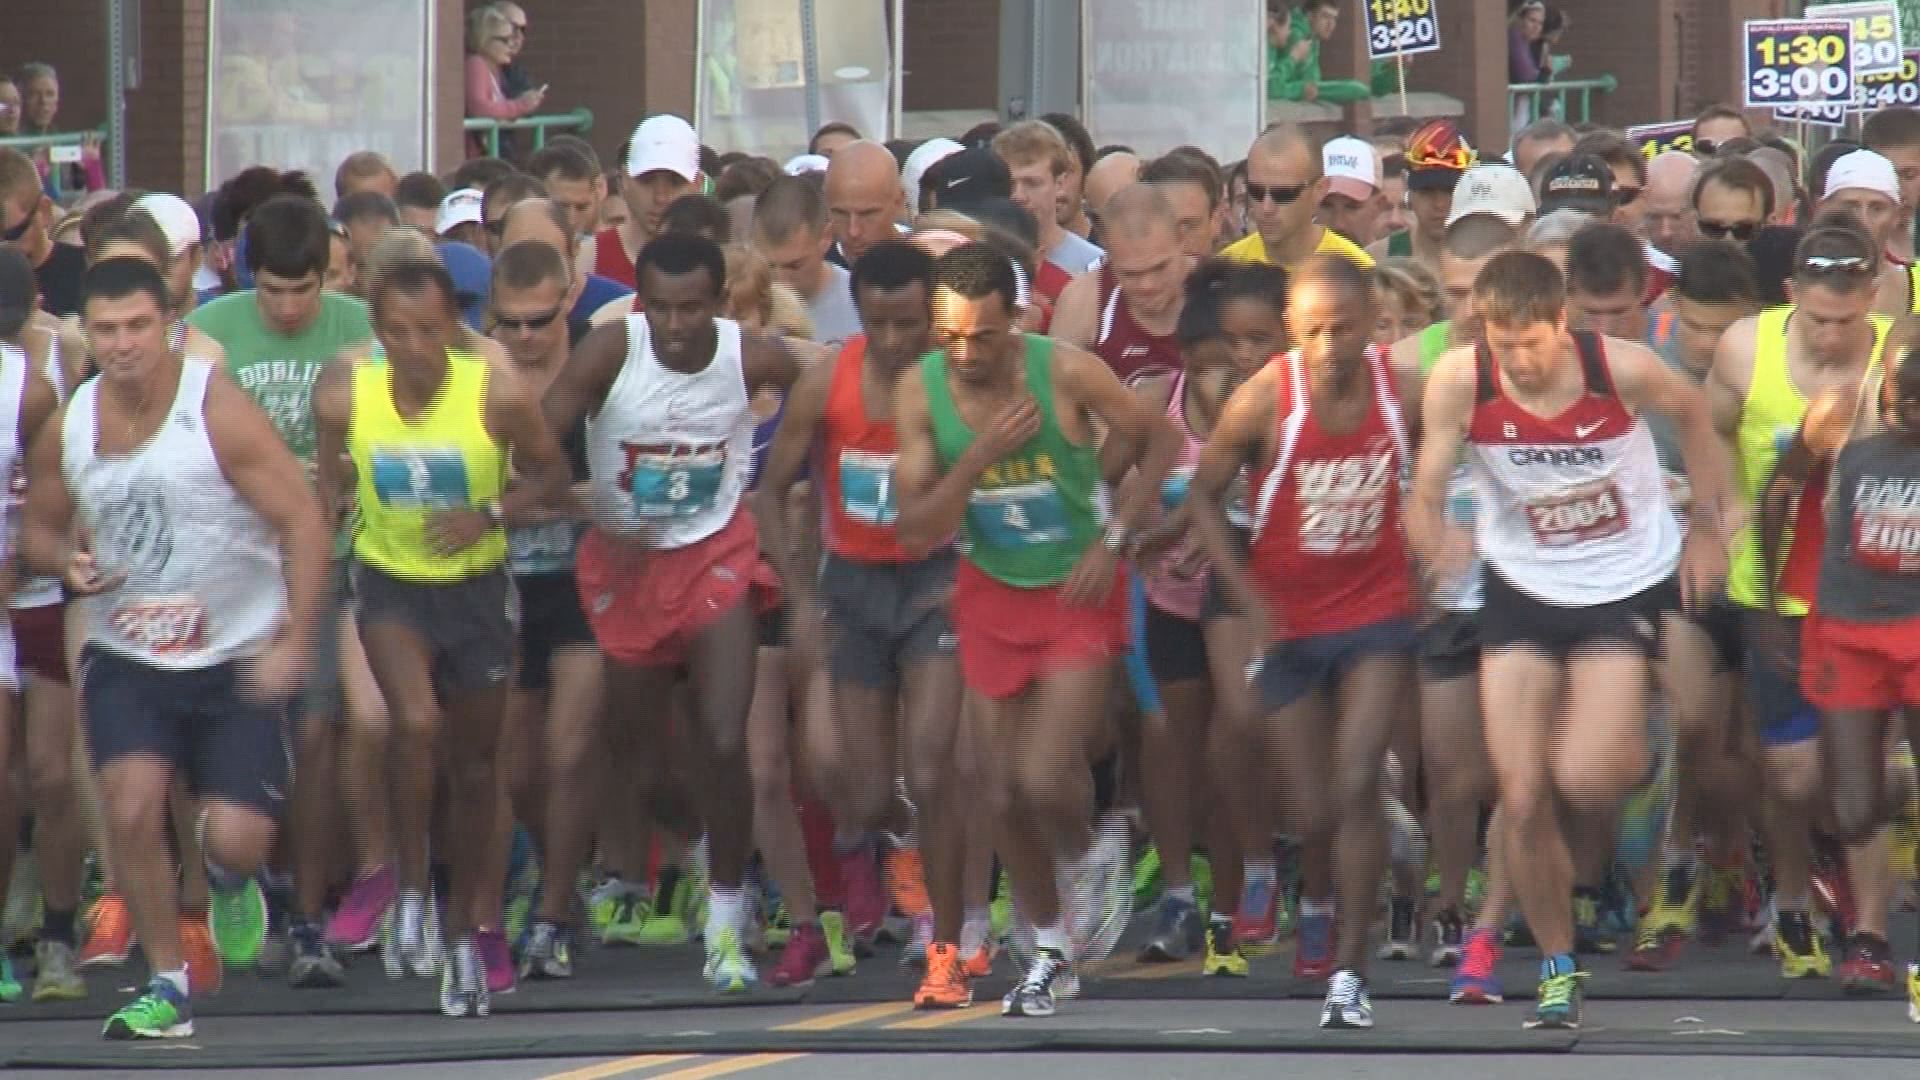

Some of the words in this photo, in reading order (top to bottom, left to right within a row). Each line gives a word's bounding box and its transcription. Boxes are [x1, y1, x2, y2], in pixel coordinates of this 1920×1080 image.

[1371, 17, 1434, 50] 3:20
[1757, 35, 1846, 66] 1:30
[1752, 67, 1848, 97] 3:00
[1509, 447, 1606, 467] CANADA
[670, 470, 691, 500] 3
[1003, 502, 1031, 531] 4
[1534, 491, 1617, 531] 2004
